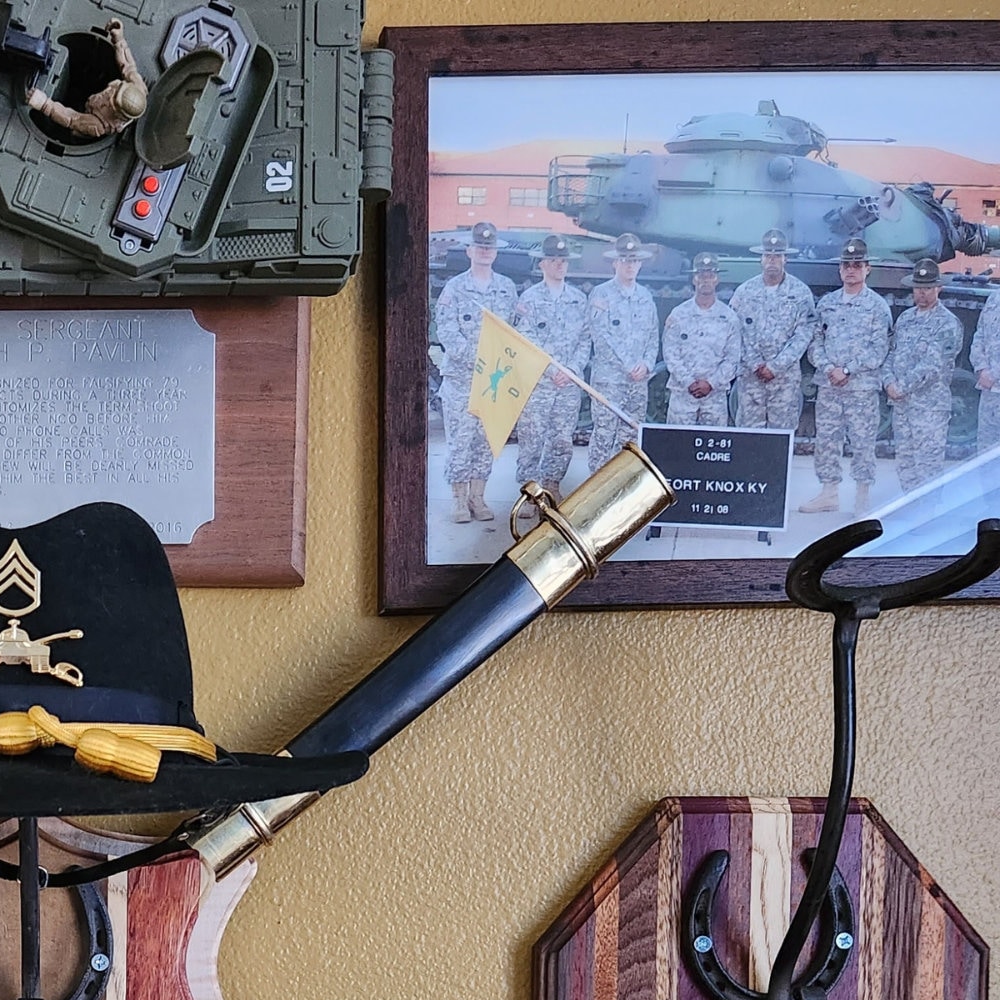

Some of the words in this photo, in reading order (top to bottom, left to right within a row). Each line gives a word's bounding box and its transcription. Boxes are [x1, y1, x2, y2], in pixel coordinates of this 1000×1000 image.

[265, 160, 293, 193] 02
[17, 318, 145, 340] SERGEANT
[29, 342, 51, 362] P.
[72, 341, 157, 362] PAVLIN
[32, 389, 81, 400] DURING
[89, 389, 97, 400] A
[48, 413, 77, 424] NCO
[695, 438, 702, 446] D
[708, 439, 732, 448] 2-81
[56, 449, 91, 460] FROM
[696, 452, 731, 462] CADRE
[28, 460, 55, 472] WILL
[91, 460, 138, 472] DEARLY
[706, 481, 744, 492] KNOX
[748, 482, 767, 494] KY
[692, 504, 700, 512] 11
[717, 505, 729, 514] 08
